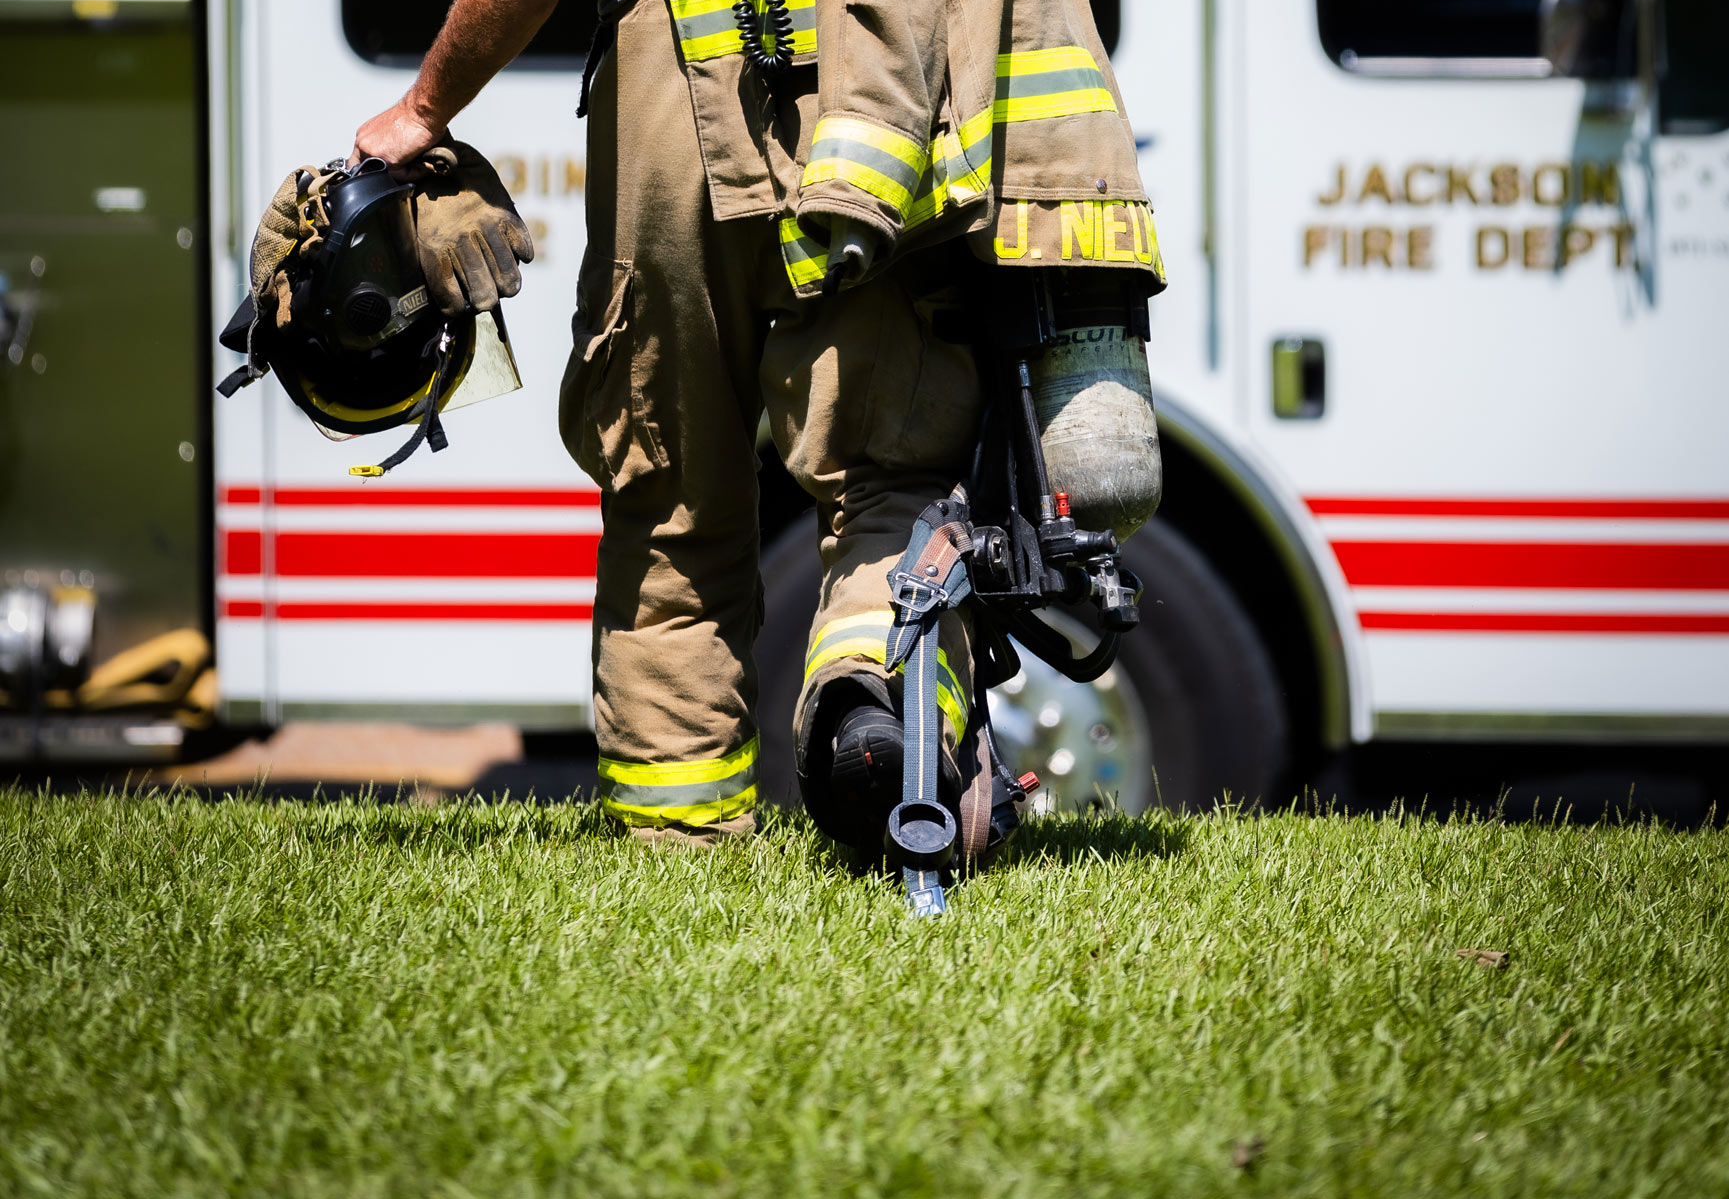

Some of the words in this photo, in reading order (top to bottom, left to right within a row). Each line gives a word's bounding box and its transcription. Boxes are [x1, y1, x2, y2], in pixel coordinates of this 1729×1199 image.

[1317, 162, 1620, 206] JACKSON
[1303, 225, 1433, 270] FIRE
[1476, 225, 1636, 270] DEPT
[1051, 345, 1125, 358] SAFETY
